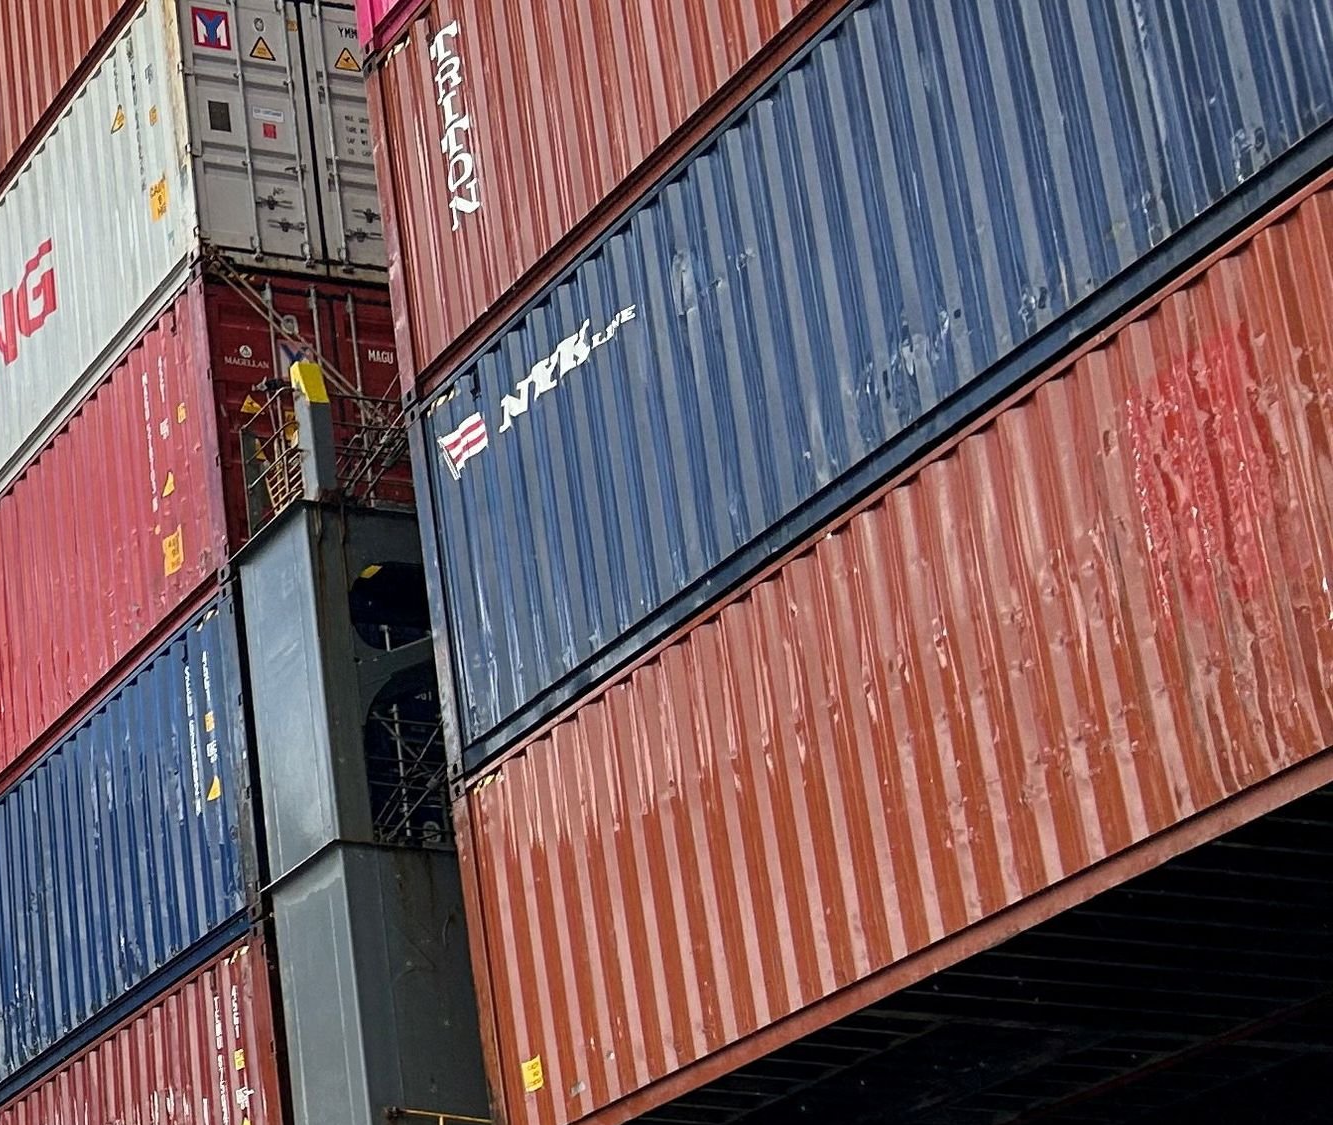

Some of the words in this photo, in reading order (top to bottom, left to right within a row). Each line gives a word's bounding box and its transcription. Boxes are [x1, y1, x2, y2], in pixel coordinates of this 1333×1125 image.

[430, 20, 482, 231] TRITON
[224, 356, 269, 369] MAGELLAN
[499, 318, 591, 433] NYK
[591, 304, 636, 349] LINE
